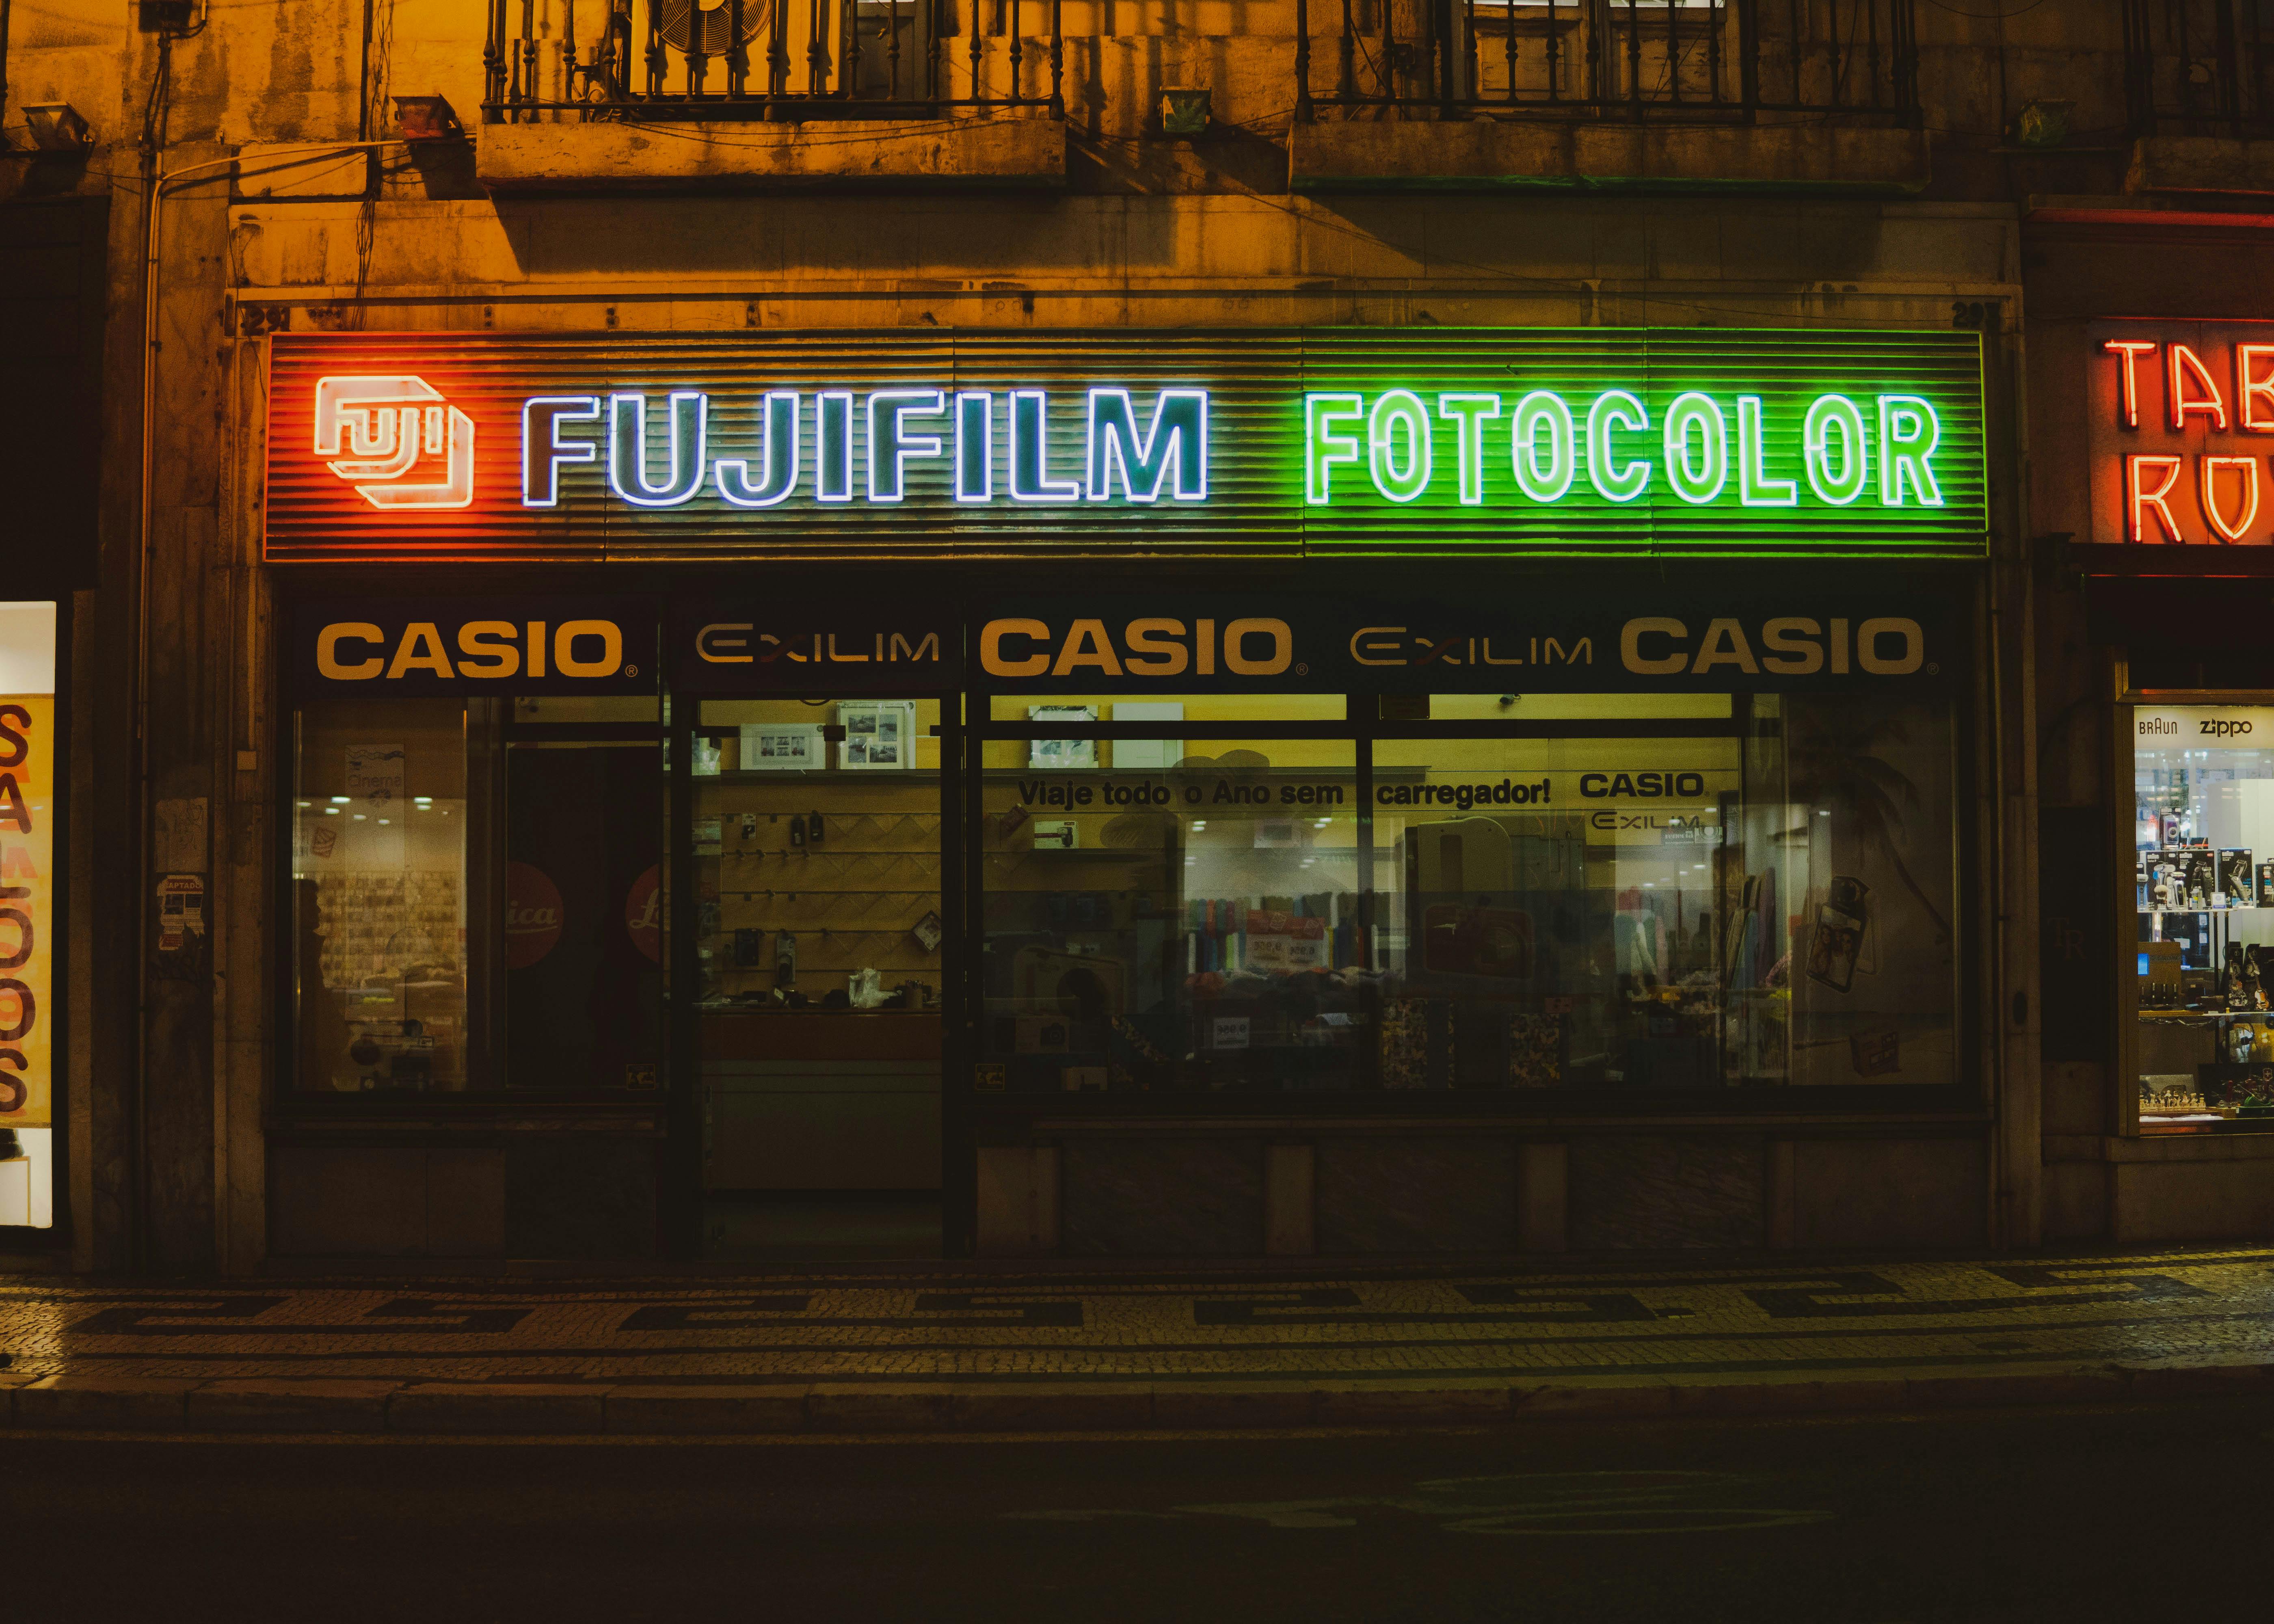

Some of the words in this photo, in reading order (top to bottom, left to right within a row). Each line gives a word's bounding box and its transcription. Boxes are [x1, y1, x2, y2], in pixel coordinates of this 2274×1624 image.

[522, 388, 1208, 508] FUJIFILM
[1303, 388, 1944, 506] FOTOCOLOR
[317, 620, 622, 680] CASIO
[696, 624, 939, 663] EXILIM
[980, 618, 1292, 677] CASIO
[1350, 627, 1592, 666] EXILIM
[1620, 617, 1924, 674] CASIO
[2139, 717, 2177, 734] BRAUN
[348, 774, 401, 787] Cinema
[1018, 780, 1093, 811] Viaje
[1102, 780, 1171, 805] todo
[1184, 786, 1202, 804] o
[1213, 779, 1271, 805] Ano
[1280, 785, 1343, 804] sem
[1377, 778, 1551, 810] carregador!
[1580, 773, 1704, 797] CASIO
[1591, 812, 1699, 829] EXILIM
